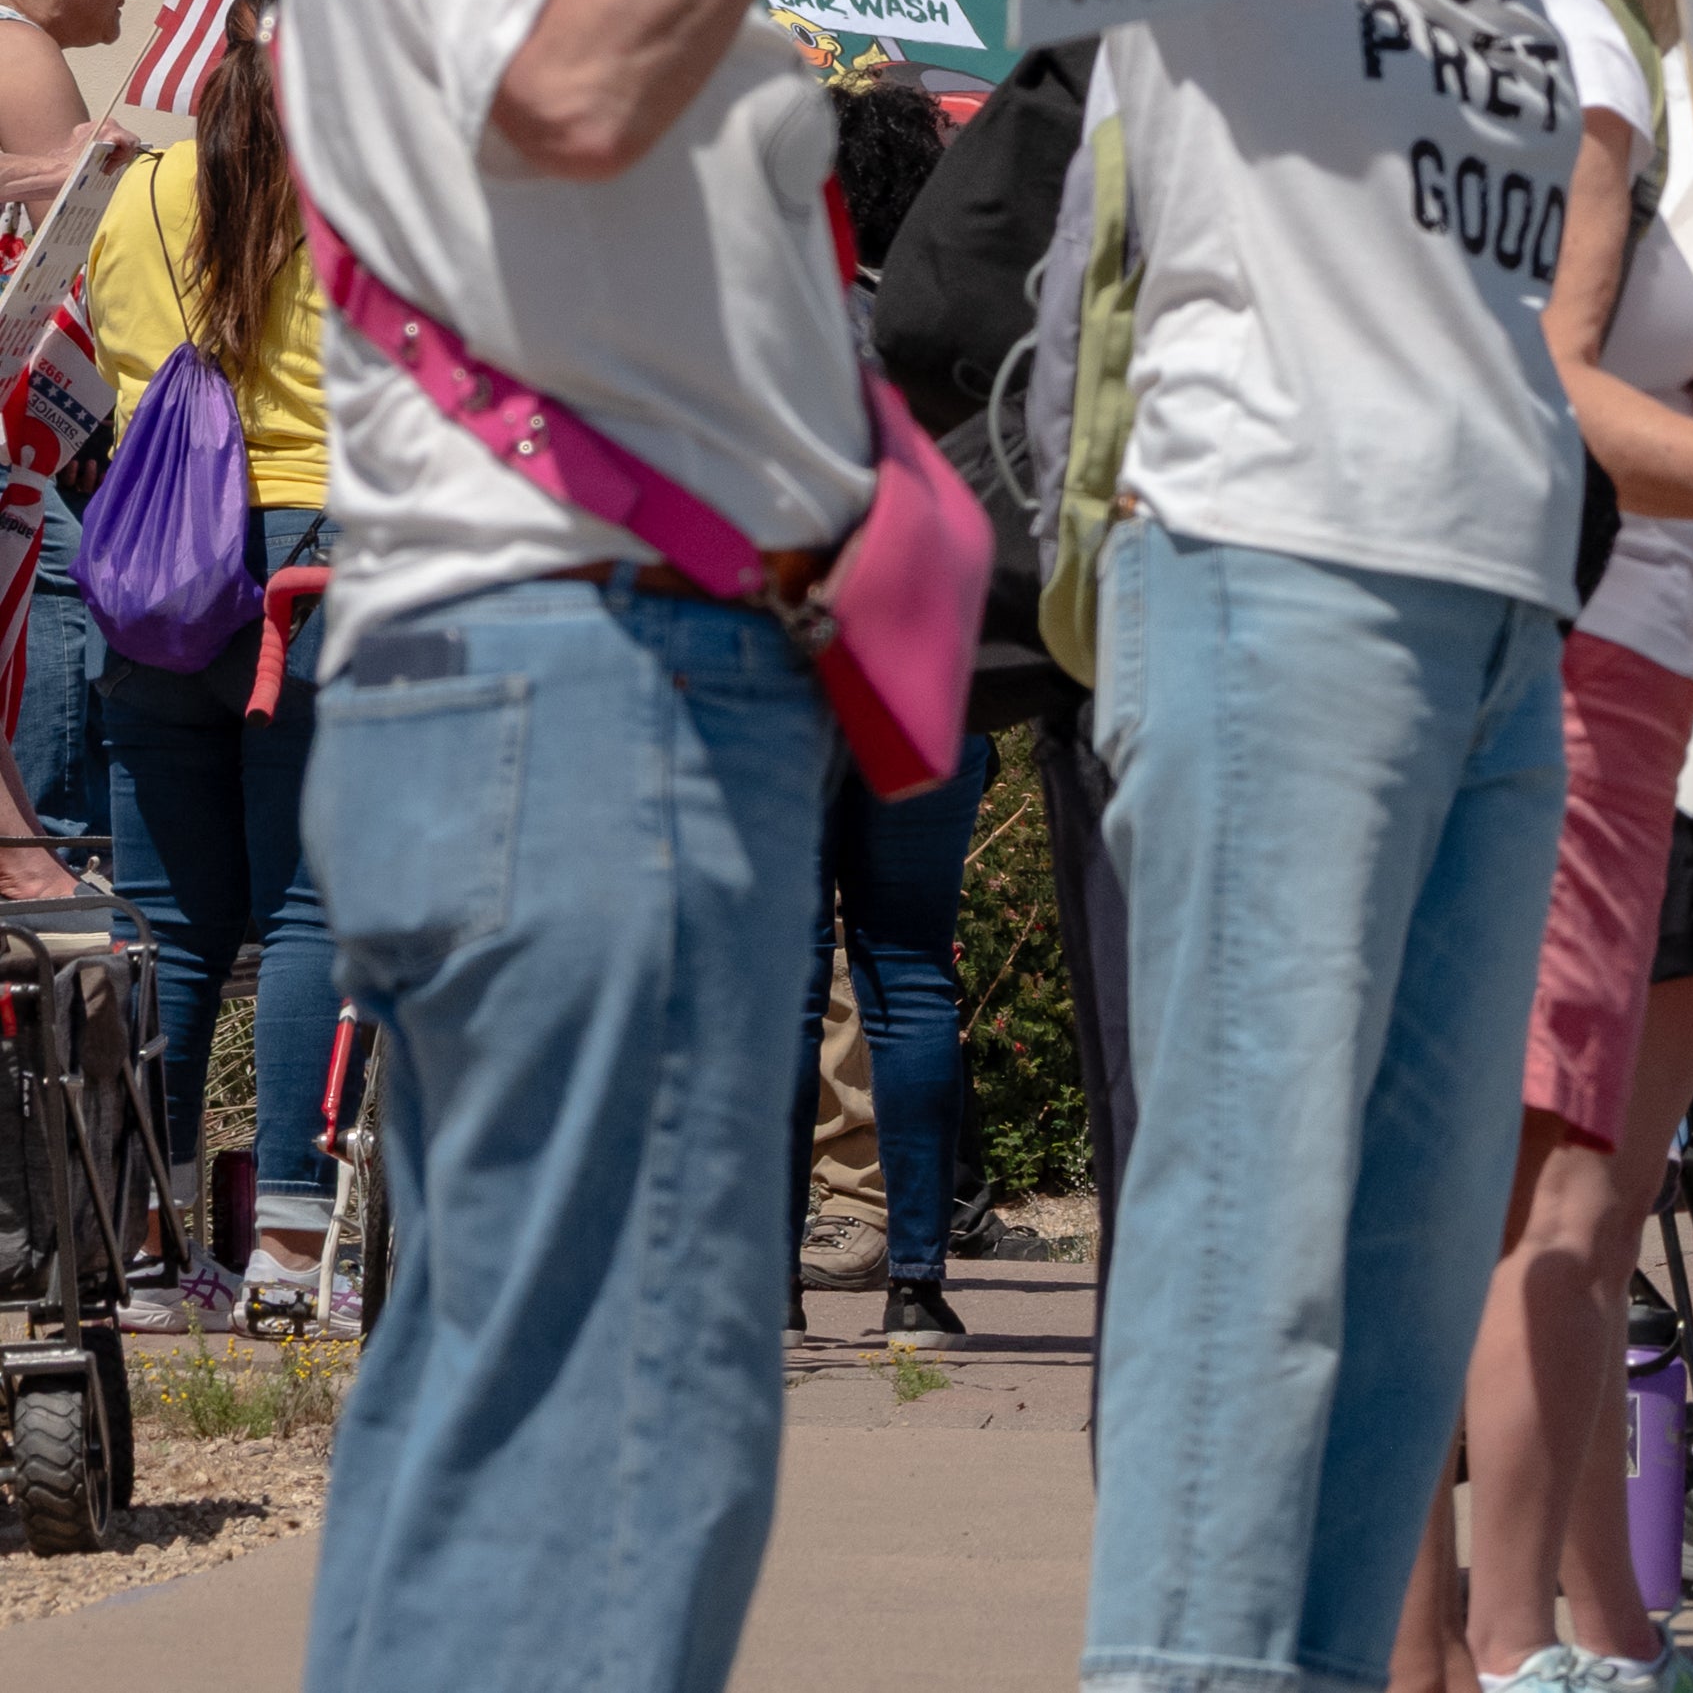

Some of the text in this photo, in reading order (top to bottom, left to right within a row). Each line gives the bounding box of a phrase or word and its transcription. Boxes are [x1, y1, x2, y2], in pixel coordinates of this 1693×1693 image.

[1410, 138, 1567, 284] GOOD
[36, 356, 74, 391] 1992
[28, 393, 79, 441] SERVICE
